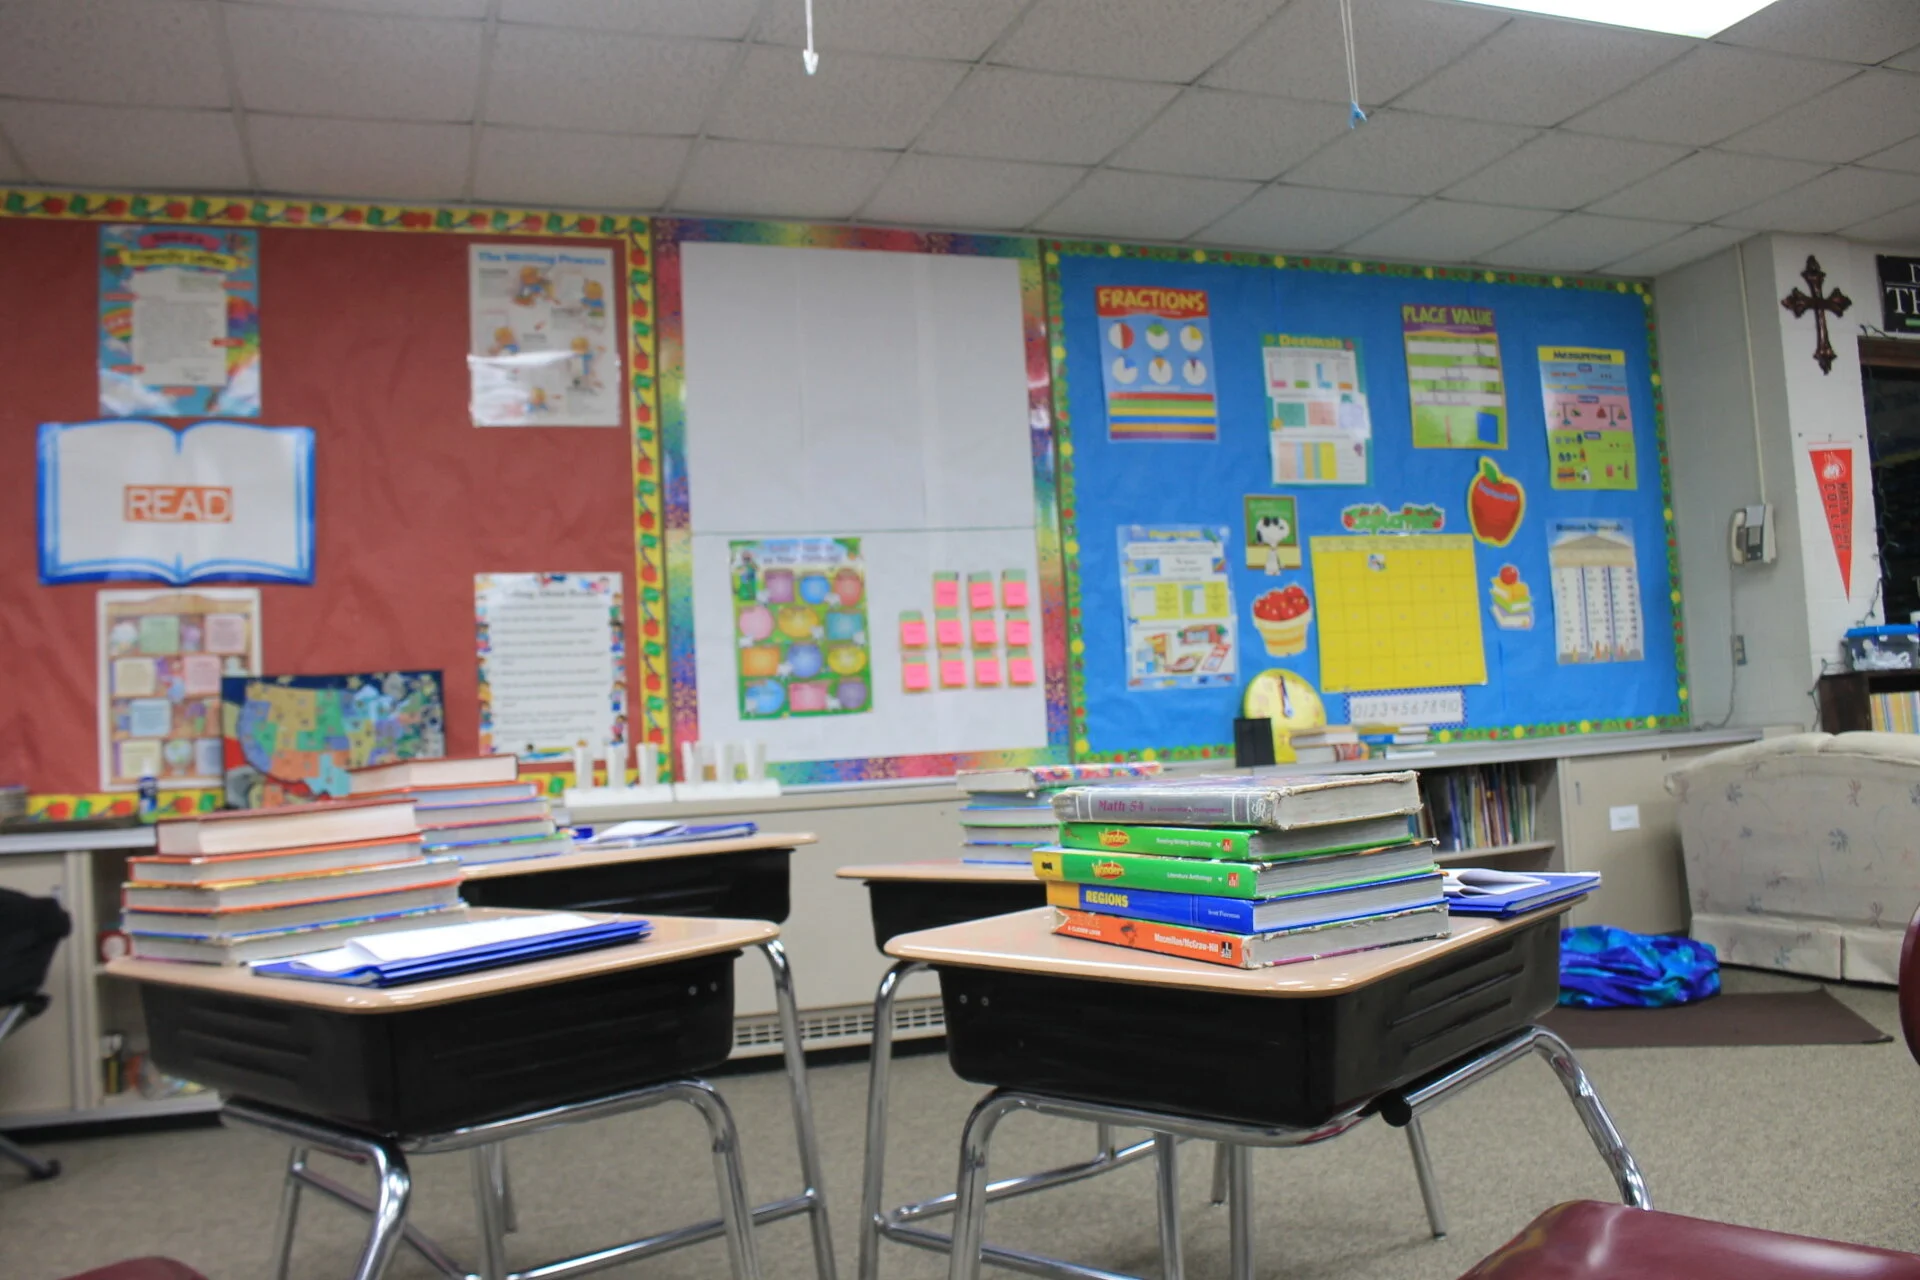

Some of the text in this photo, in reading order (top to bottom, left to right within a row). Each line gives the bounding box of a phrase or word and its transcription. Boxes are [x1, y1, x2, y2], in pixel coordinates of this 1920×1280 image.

[1099, 288, 1205, 312] FRACTIONS
[1403, 304, 1494, 327] PLACE VALUE
[1553, 350, 1613, 362] Measurement
[128, 487, 232, 521] READ
[1098, 800, 1125, 812] Math
[1097, 828, 1130, 847] Wonders
[1091, 860, 1125, 879] Wonders
[1085, 889, 1129, 908] REGIONS
[1154, 932, 1219, 953] Macmillan/McGraw-Hill
